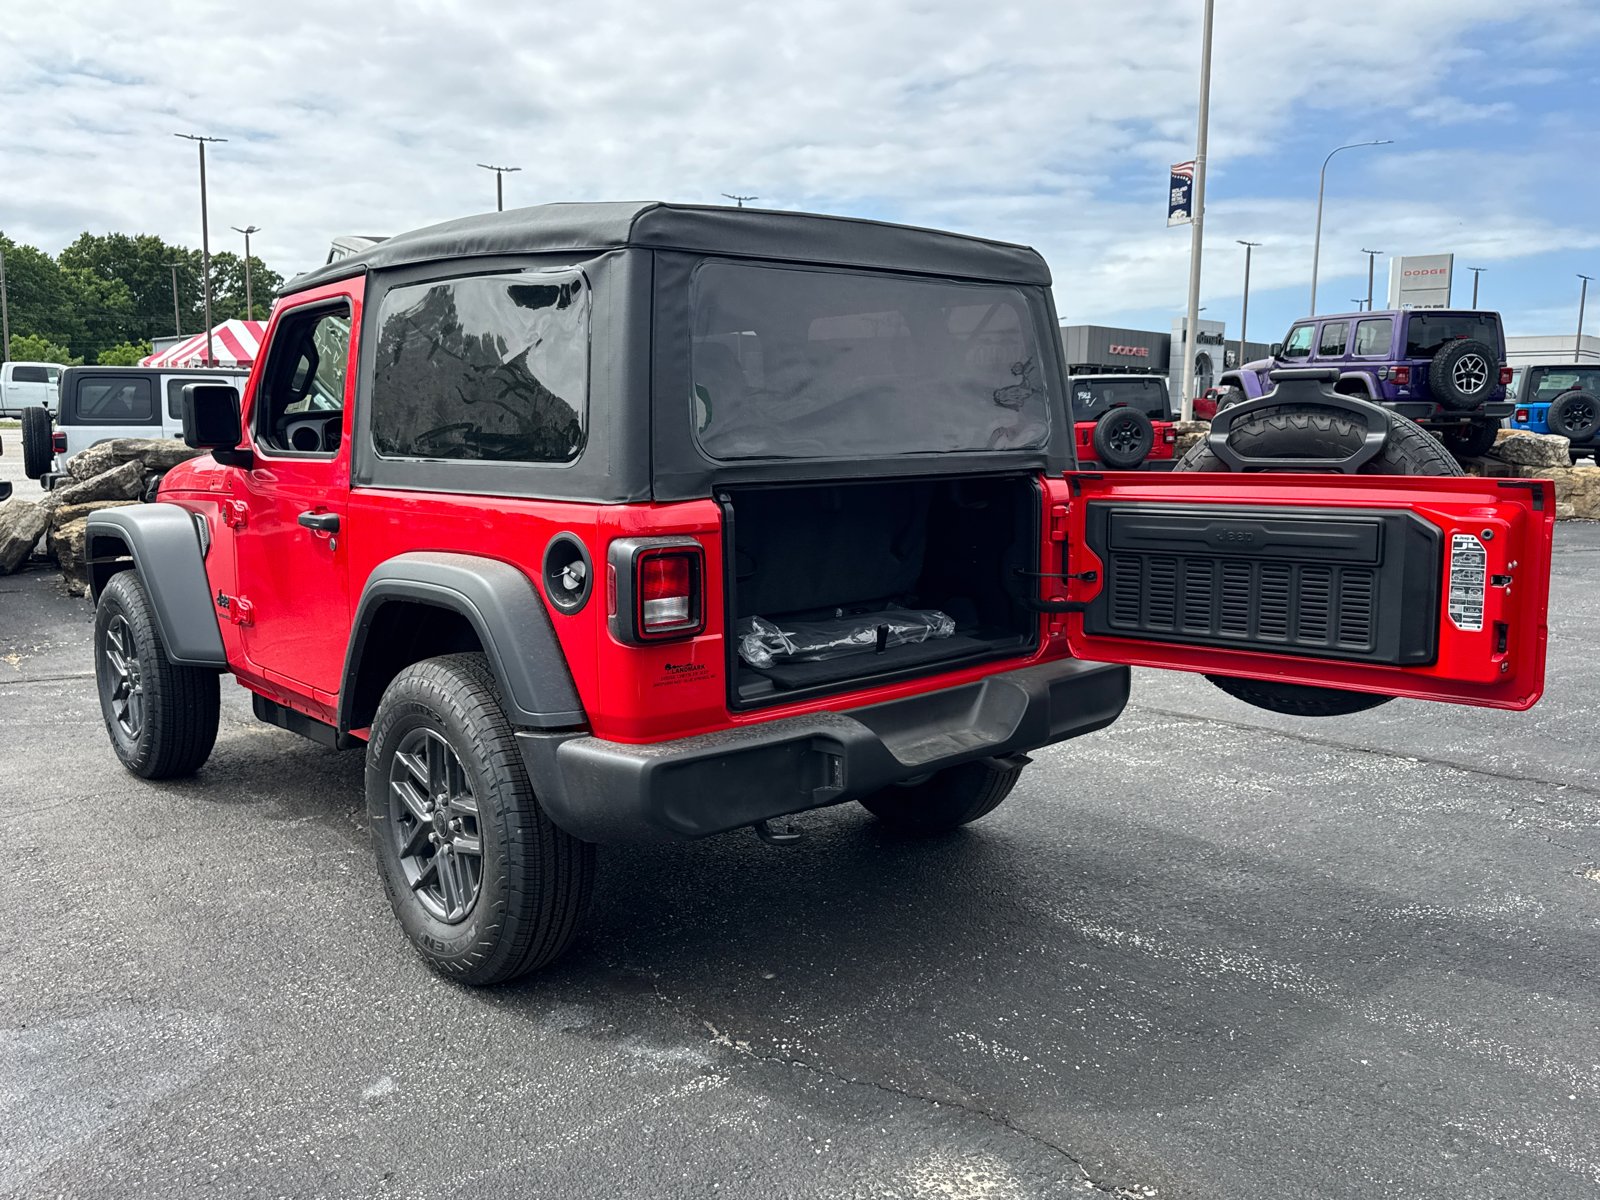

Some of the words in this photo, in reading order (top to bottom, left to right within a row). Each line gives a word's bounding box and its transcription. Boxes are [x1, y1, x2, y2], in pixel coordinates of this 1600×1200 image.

[1404, 268, 1446, 276] DODGE
[1182, 329, 1224, 346] Lndmark
[1109, 344, 1149, 357] DODGE
[1217, 528, 1254, 541] Jeep
[216, 589, 230, 609] Jee
[672, 664, 705, 674] LANDMARK
[423, 924, 477, 954] NEXEN
